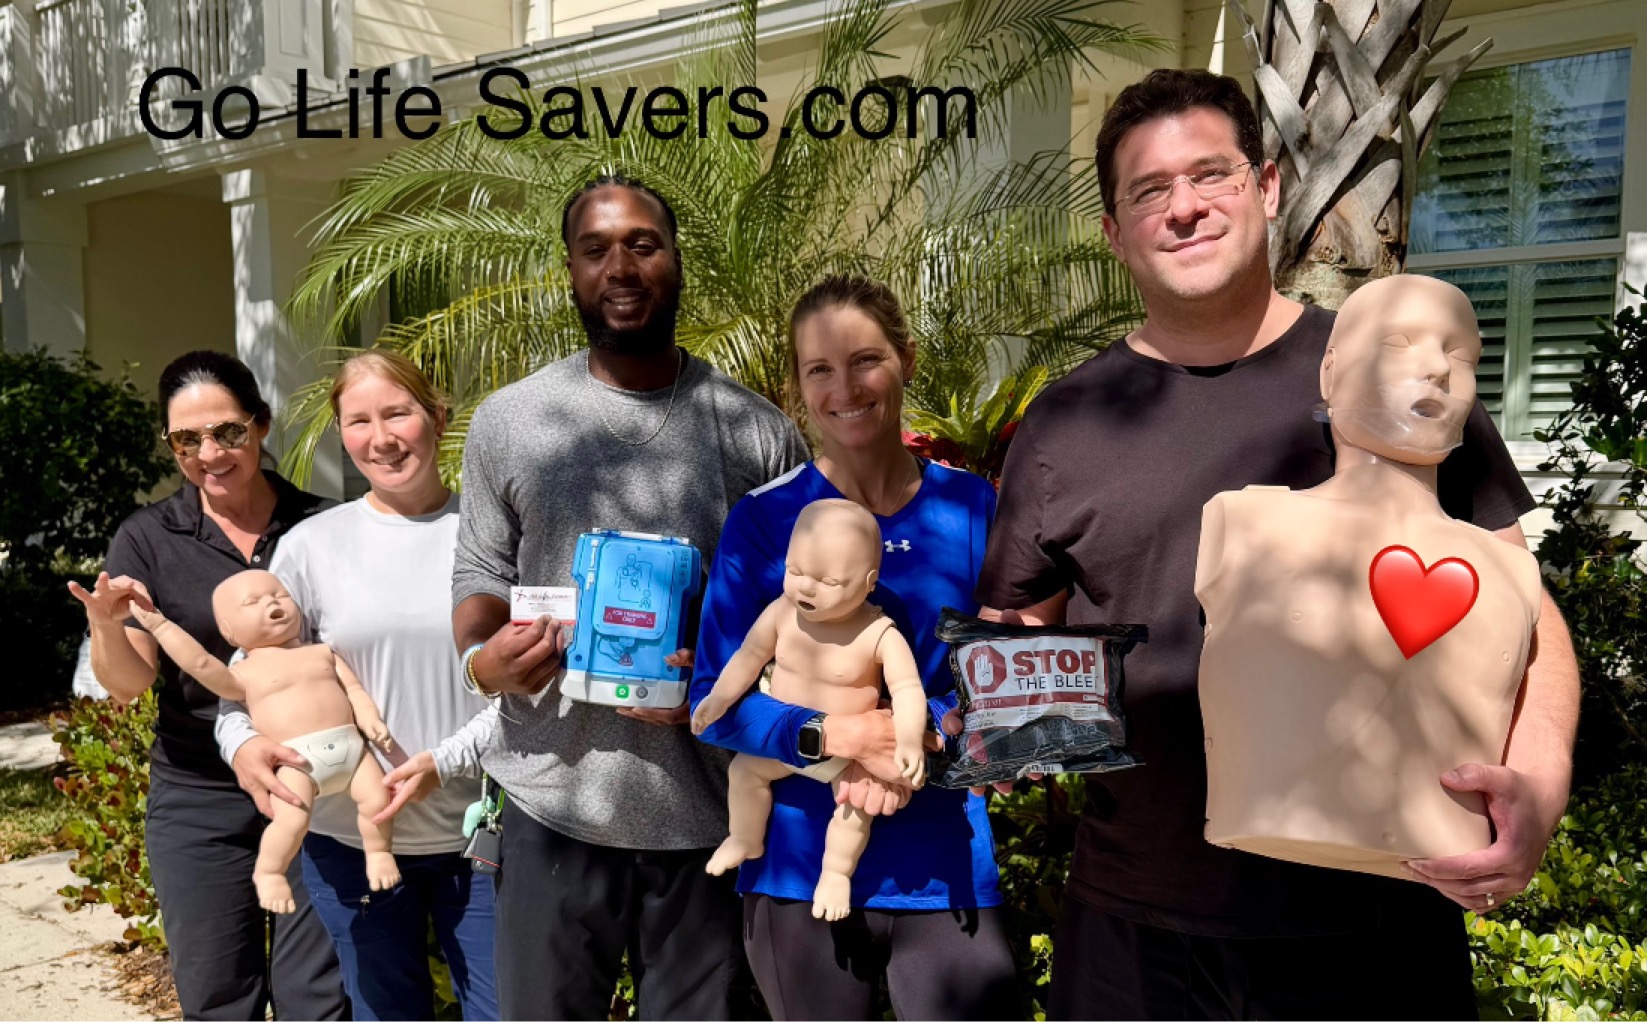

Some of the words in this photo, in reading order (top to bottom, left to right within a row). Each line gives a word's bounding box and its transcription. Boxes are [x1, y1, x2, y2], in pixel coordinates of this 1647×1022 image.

[623, 611, 647, 619] TRAINING
[1012, 649, 1096, 676] STOP
[1015, 676, 1047, 691] THE
[1054, 674, 1099, 689] BLEE
